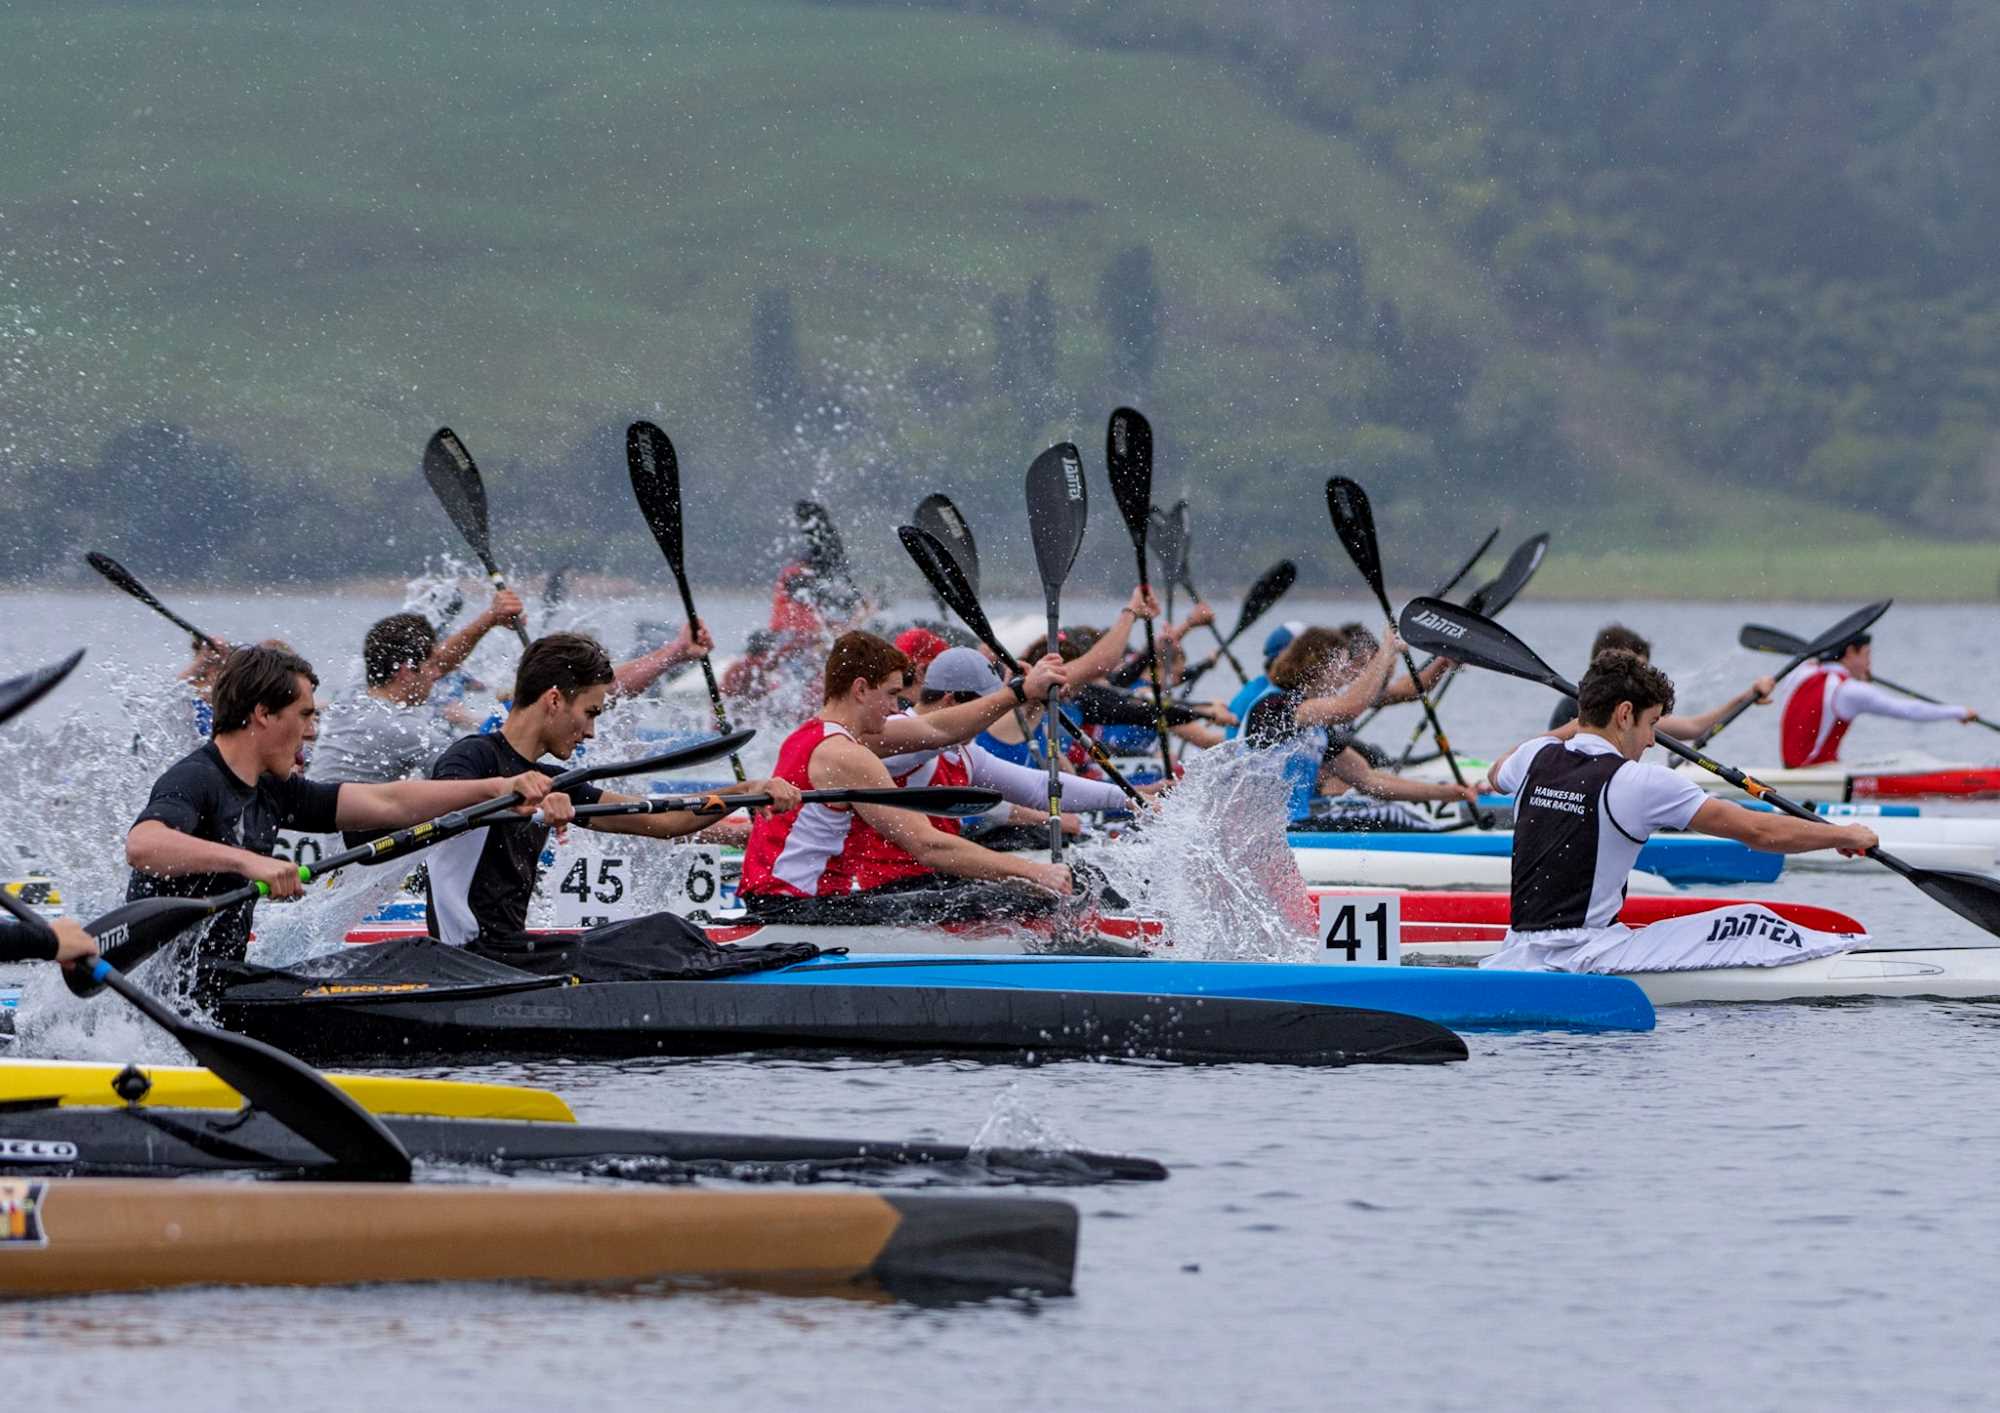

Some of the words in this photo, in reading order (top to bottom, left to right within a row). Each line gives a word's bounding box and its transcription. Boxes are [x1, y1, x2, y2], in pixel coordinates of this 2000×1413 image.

[1410, 609, 1468, 639] JANTEX
[1529, 797, 1552, 808] KAYAK
[1553, 801, 1586, 815] RACING
[1534, 786, 1569, 799] HAWKES
[1569, 792, 1586, 802] BAY
[560, 857, 624, 905] 45
[95, 922, 130, 956] NTEX
[1325, 902, 1388, 962] 41
[1705, 912, 1803, 948] JANTEX
[0, 1142, 73, 1157] ELO
